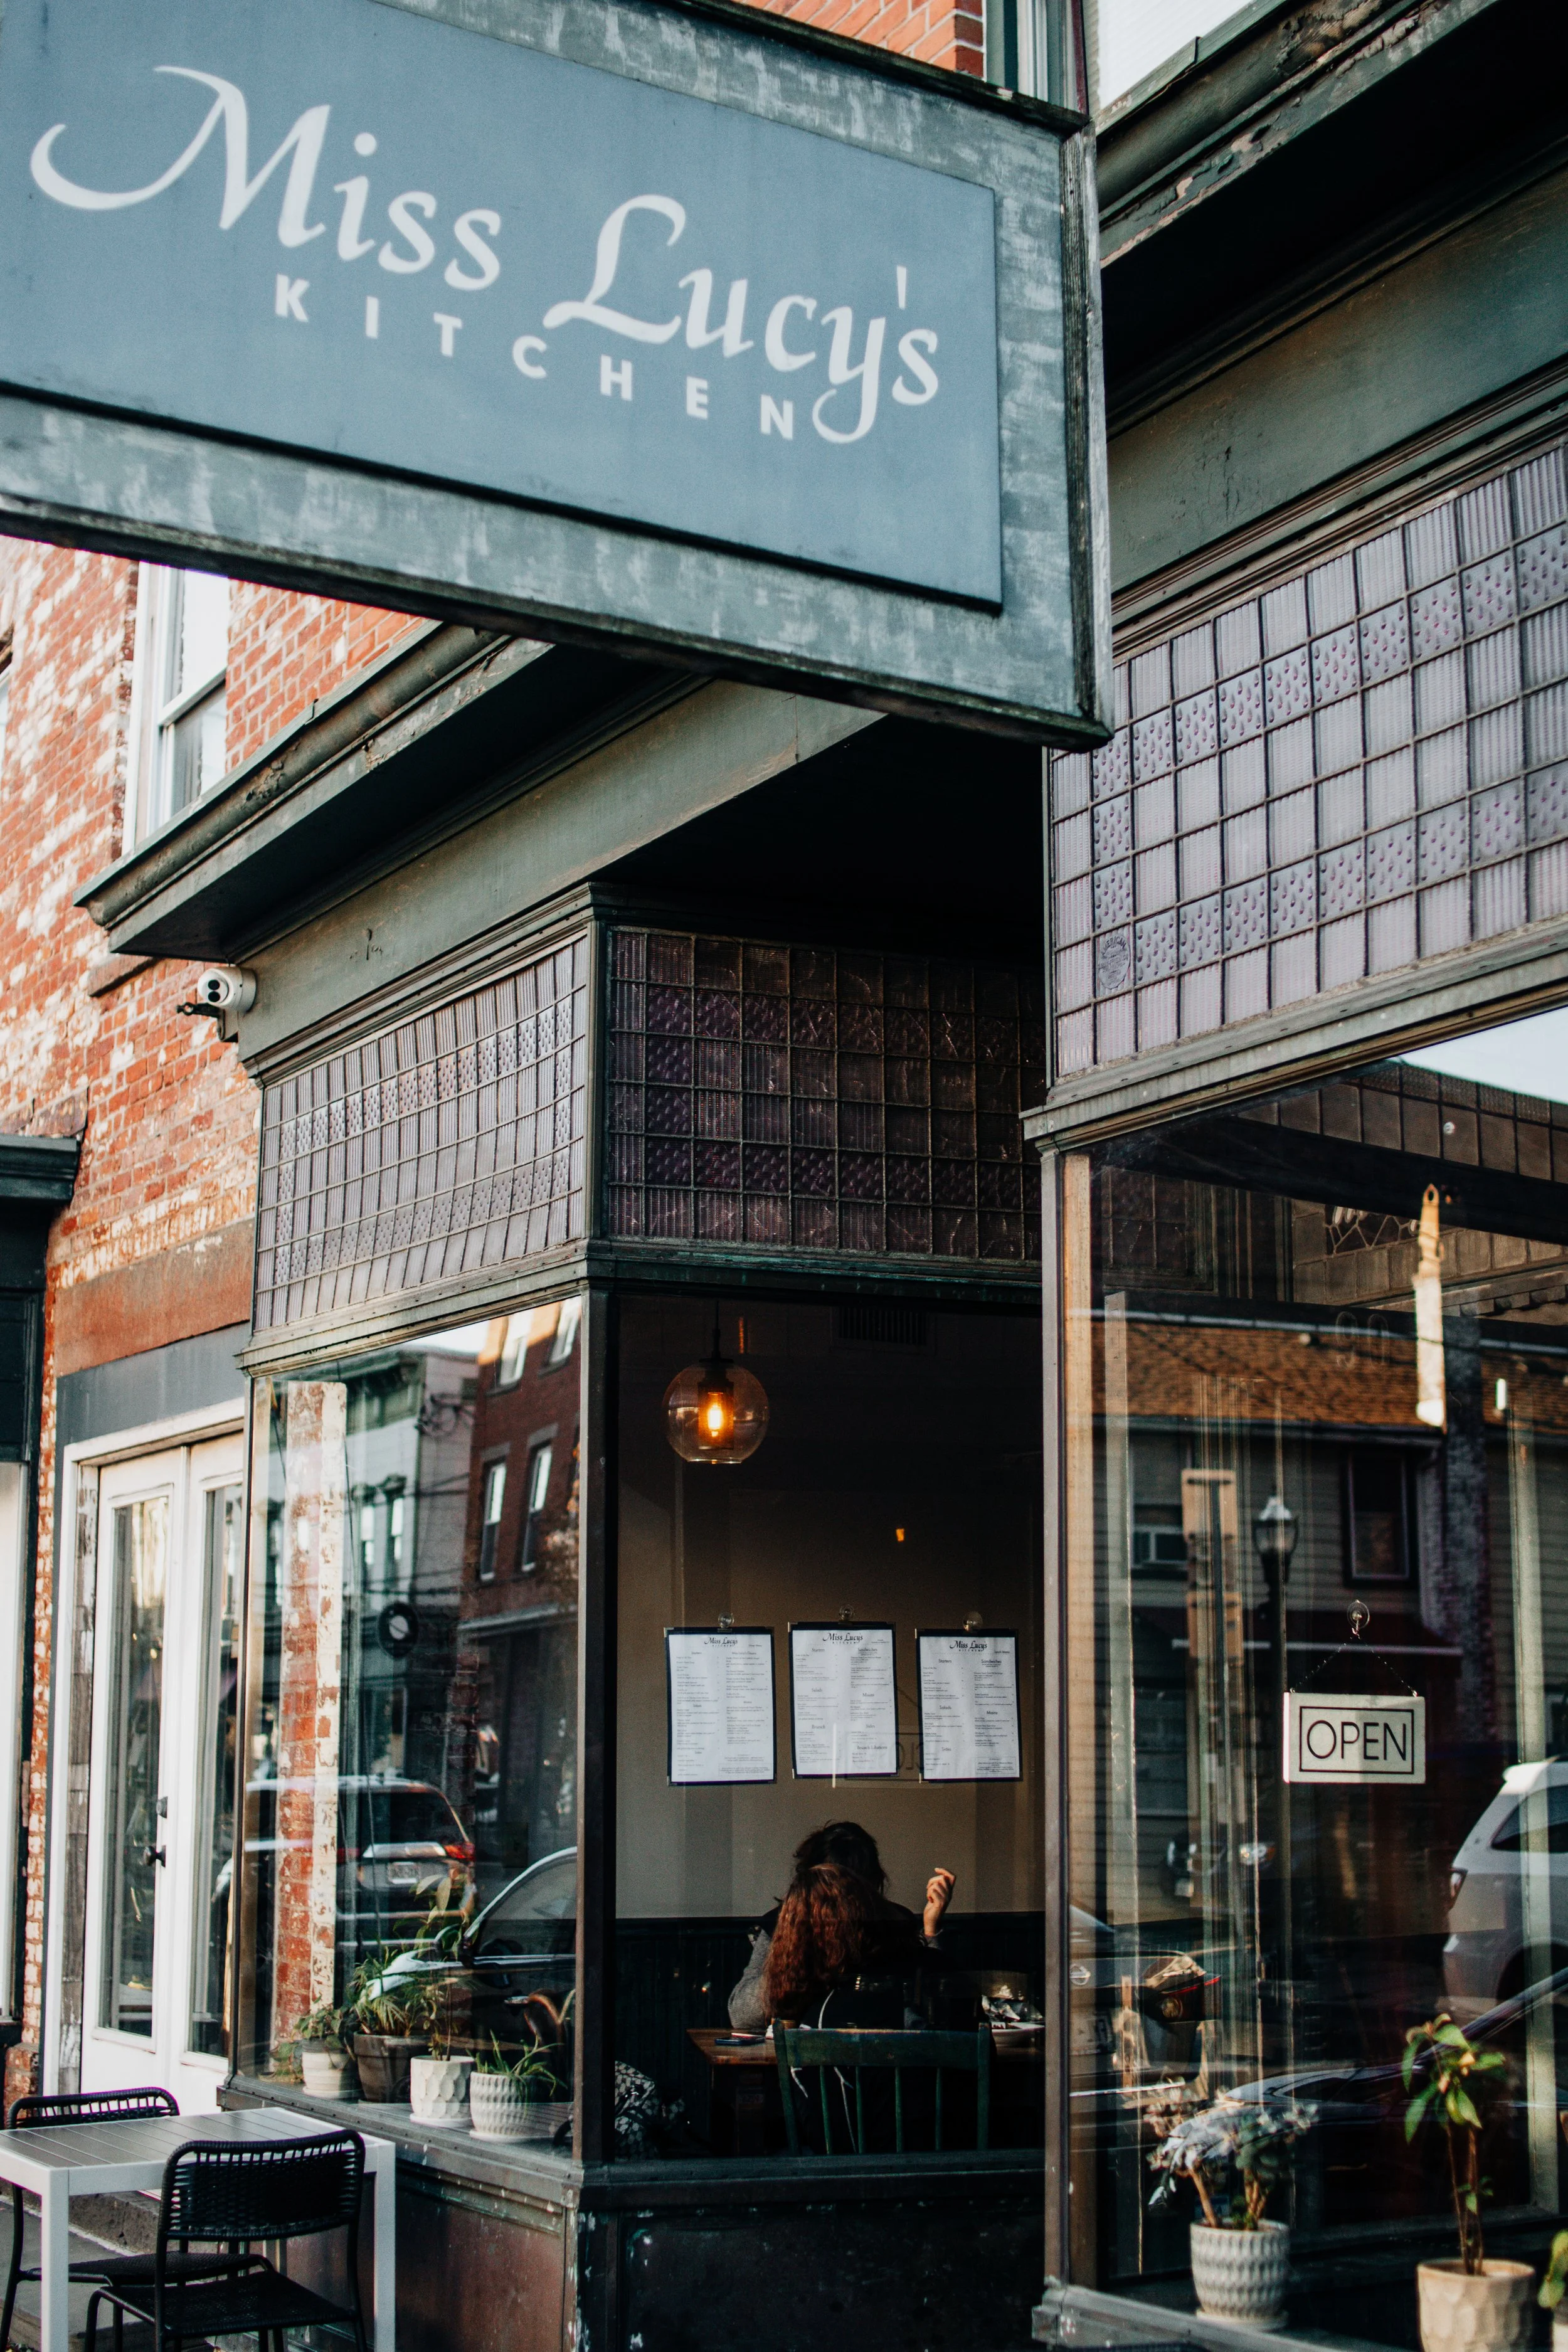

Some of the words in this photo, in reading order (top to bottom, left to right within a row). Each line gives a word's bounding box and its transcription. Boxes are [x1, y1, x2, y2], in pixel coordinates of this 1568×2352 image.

[30, 65, 501, 291] Miss
[542, 194, 939, 443] Lucy's
[274, 273, 794, 440] KITCHEN
[704, 1636, 721, 1645] Miss
[722, 1636, 738, 1646] Lucy's
[822, 1633, 843, 1641] Miss
[844, 1632, 863, 1644] Lucy's
[949, 1640, 968, 1649] Miss
[969, 1640, 988, 1651] Lucy's
[1306, 1720, 1406, 1761] OPEN
